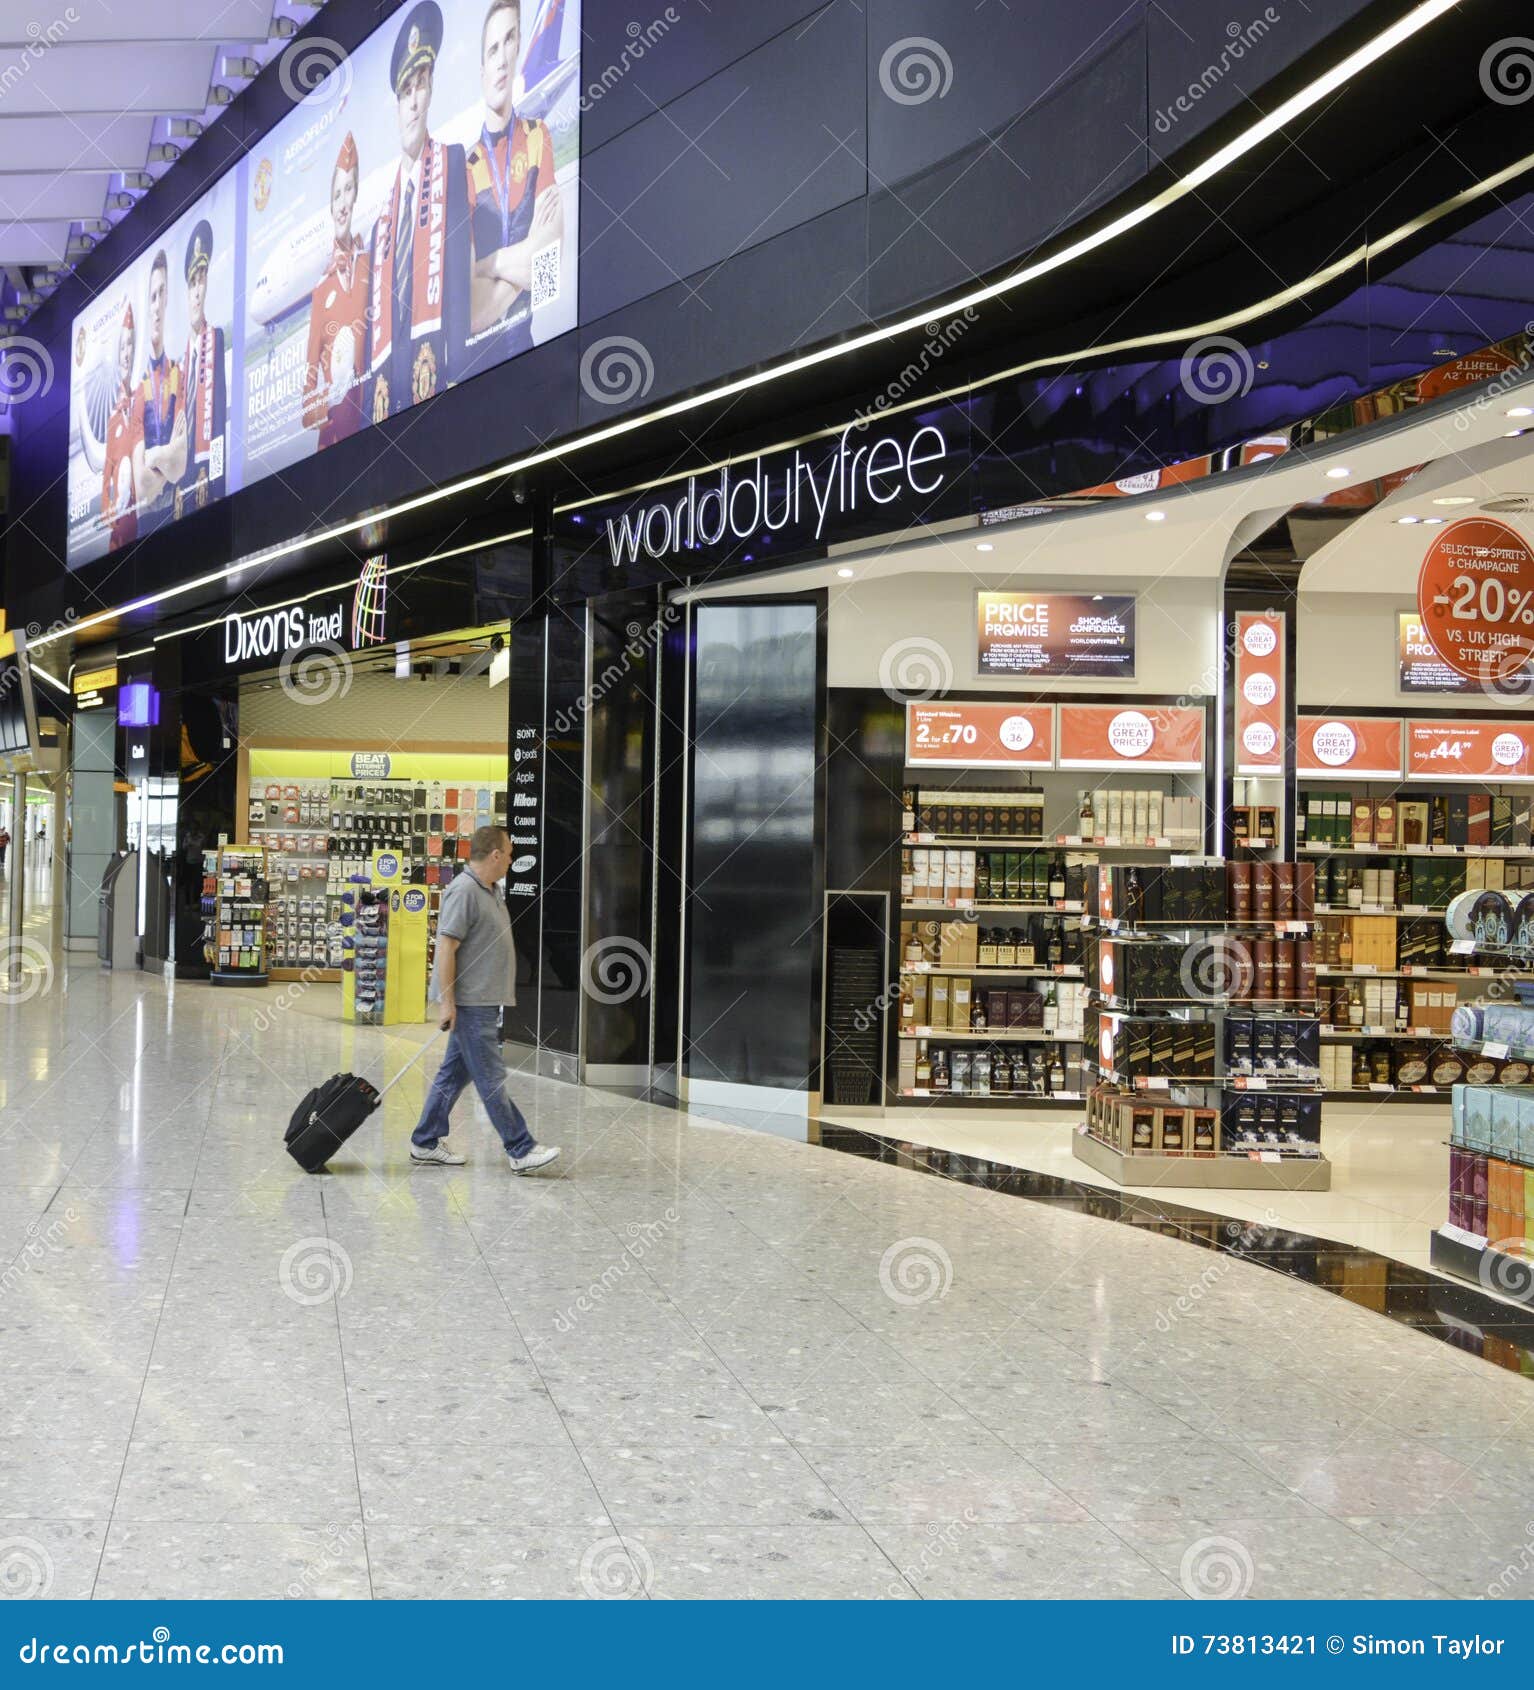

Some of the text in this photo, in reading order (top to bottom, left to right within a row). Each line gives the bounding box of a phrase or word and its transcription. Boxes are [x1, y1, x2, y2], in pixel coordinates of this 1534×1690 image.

[249, 362, 268, 392] TOP
[248, 361, 309, 418] RELIABILITY
[606, 420, 946, 567] worlddutyfree
[1441, 543, 1527, 561] SELECTED SPIRITS
[1448, 558, 1520, 574] & CHAMPAGNE
[1433, 575, 1534, 625] -20%
[985, 603, 1049, 622] PRICE
[1078, 616, 1101, 625] SHOP
[225, 603, 343, 664] Dixons travel
[985, 623, 1049, 637] PROMISE
[1069, 624, 1126, 633] CONFIDENCE
[1446, 629, 1520, 647] VS. UK HIGH
[516, 729, 537, 739] SONY
[916, 723, 977, 744] 2 for £70
[1112, 728, 1149, 738] GREAT
[1112, 738, 1149, 747] PRICES
[1317, 738, 1351, 747] GREAT
[522, 748, 538, 760] beats
[1317, 747, 1351, 756] PRICES
[1414, 751, 1429, 759] Only
[355, 753, 386, 764] BEAT
[355, 769, 385, 777] PRICES
[516, 771, 535, 783] Apple
[513, 793, 538, 807] Nikon
[514, 815, 536, 826] Canon
[510, 834, 538, 845] Panasonic
[513, 883, 538, 893] BOSE
